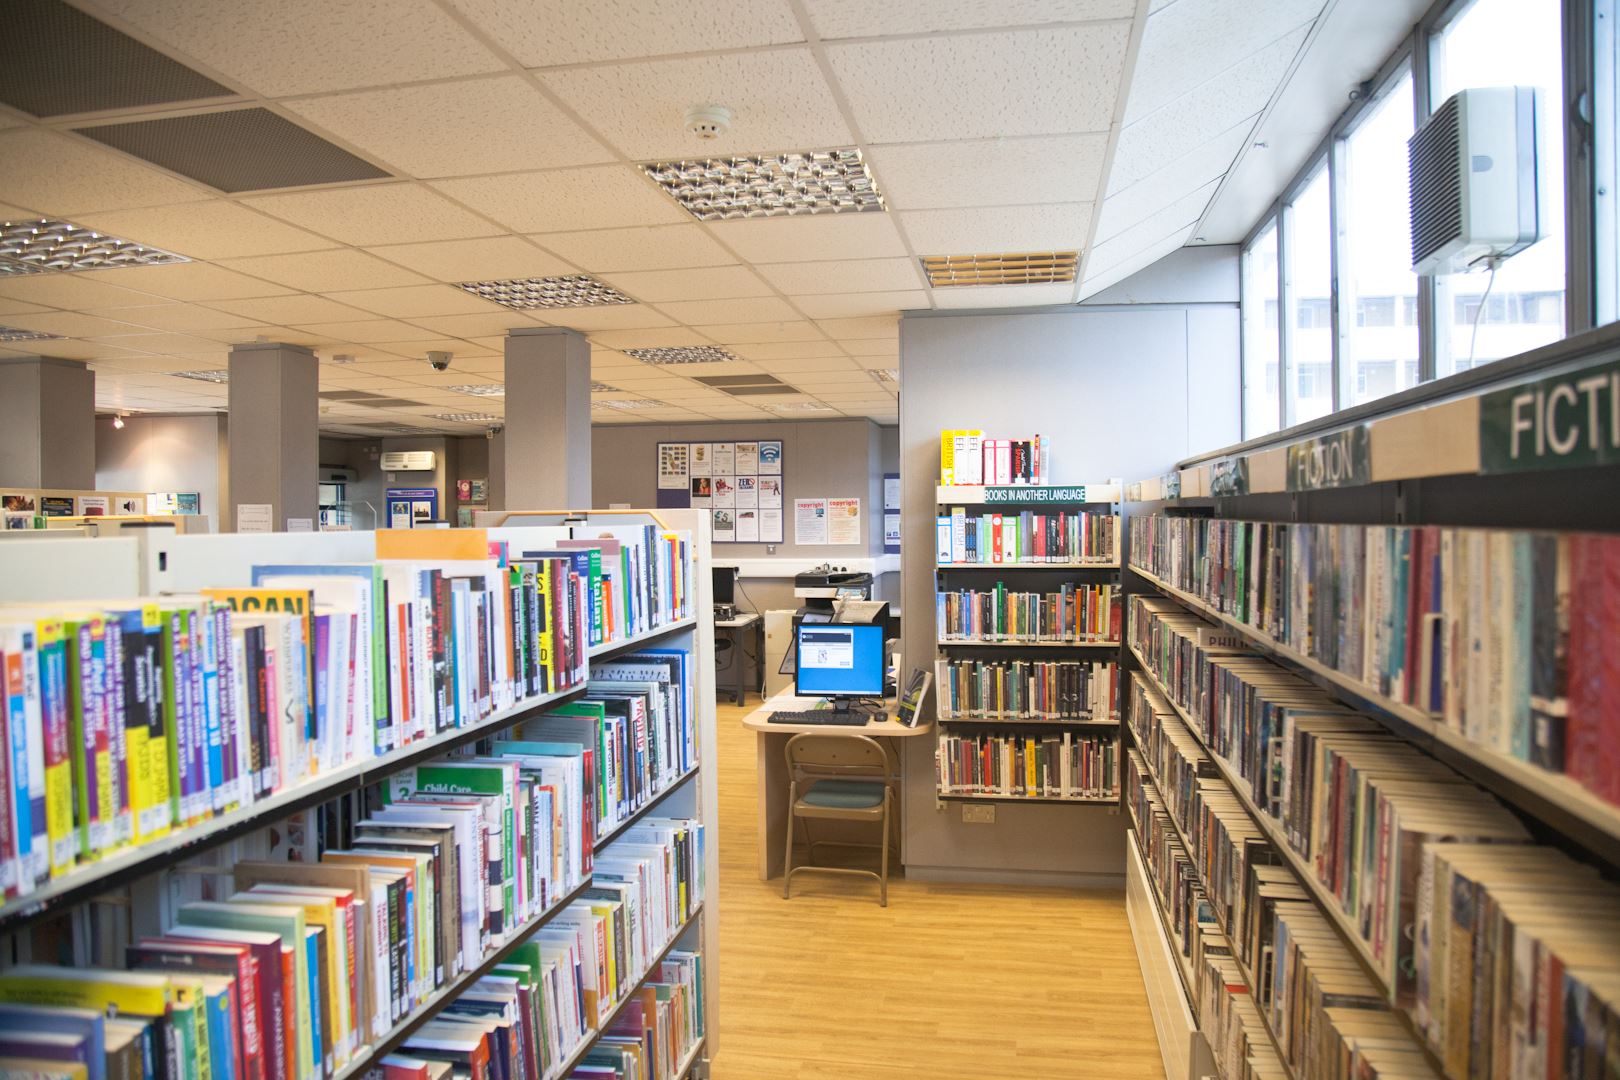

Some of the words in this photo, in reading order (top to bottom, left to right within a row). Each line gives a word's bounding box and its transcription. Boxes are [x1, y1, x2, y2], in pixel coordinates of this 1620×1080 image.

[985, 490, 1007, 501] BOOKS
[1008, 490, 1015, 501] IN
[1016, 490, 1048, 501] ANOTHER
[1049, 489, 1085, 501] LANGUAGE
[594, 576, 602, 626] Italian
[216, 611, 226, 662] WINDOWS
[135, 655, 147, 703] Scratch
[636, 699, 644, 750] PACIFIC
[209, 731, 219, 747] 10
[424, 783, 448, 793] Child
[450, 784, 472, 793] Care
[390, 888, 399, 914] MATT
[391, 915, 399, 943] LEWIS
[391, 945, 400, 967] LAST
[392, 969, 400, 990] MAN
